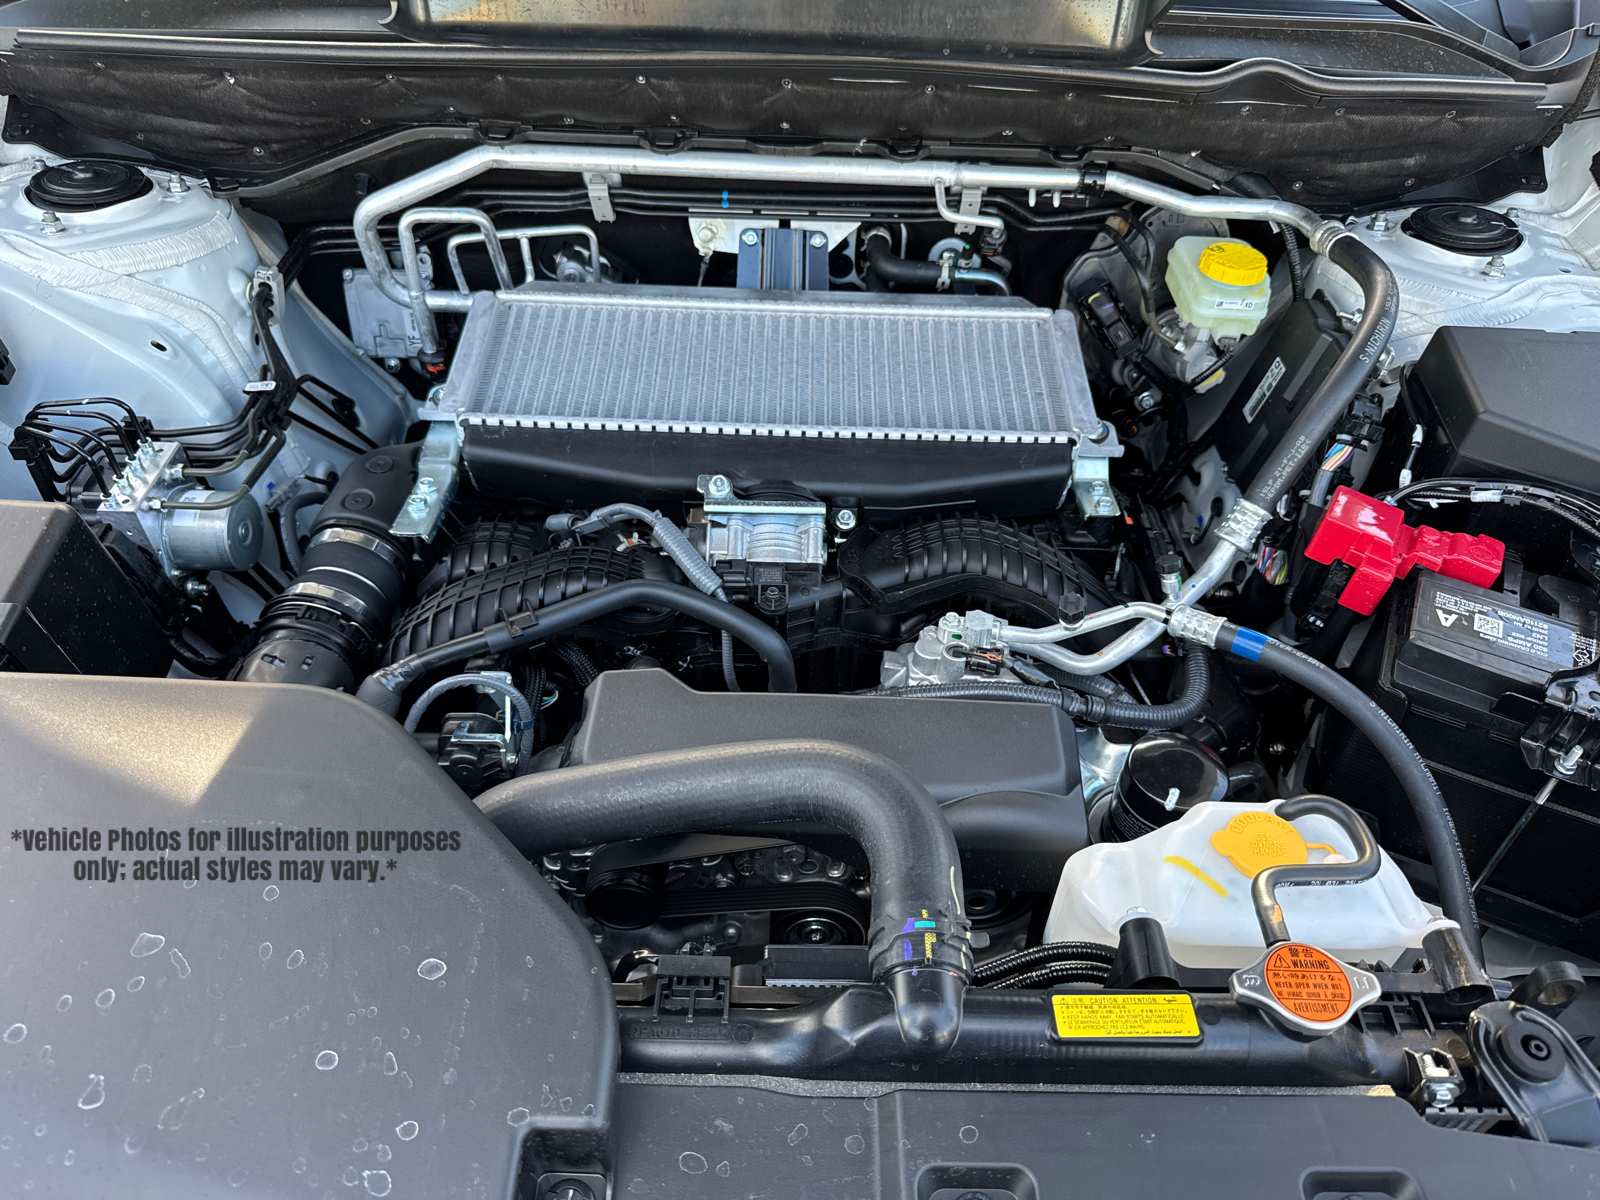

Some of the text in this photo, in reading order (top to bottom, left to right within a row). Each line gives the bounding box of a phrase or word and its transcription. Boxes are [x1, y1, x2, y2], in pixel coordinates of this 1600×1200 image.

[1506, 636, 1532, 647] AMPS
[1531, 632, 1548, 640] LN2
[1231, 813, 1294, 834] COOLANT
[1288, 947, 1313, 958] 警告
[1291, 959, 1330, 970] WARNING
